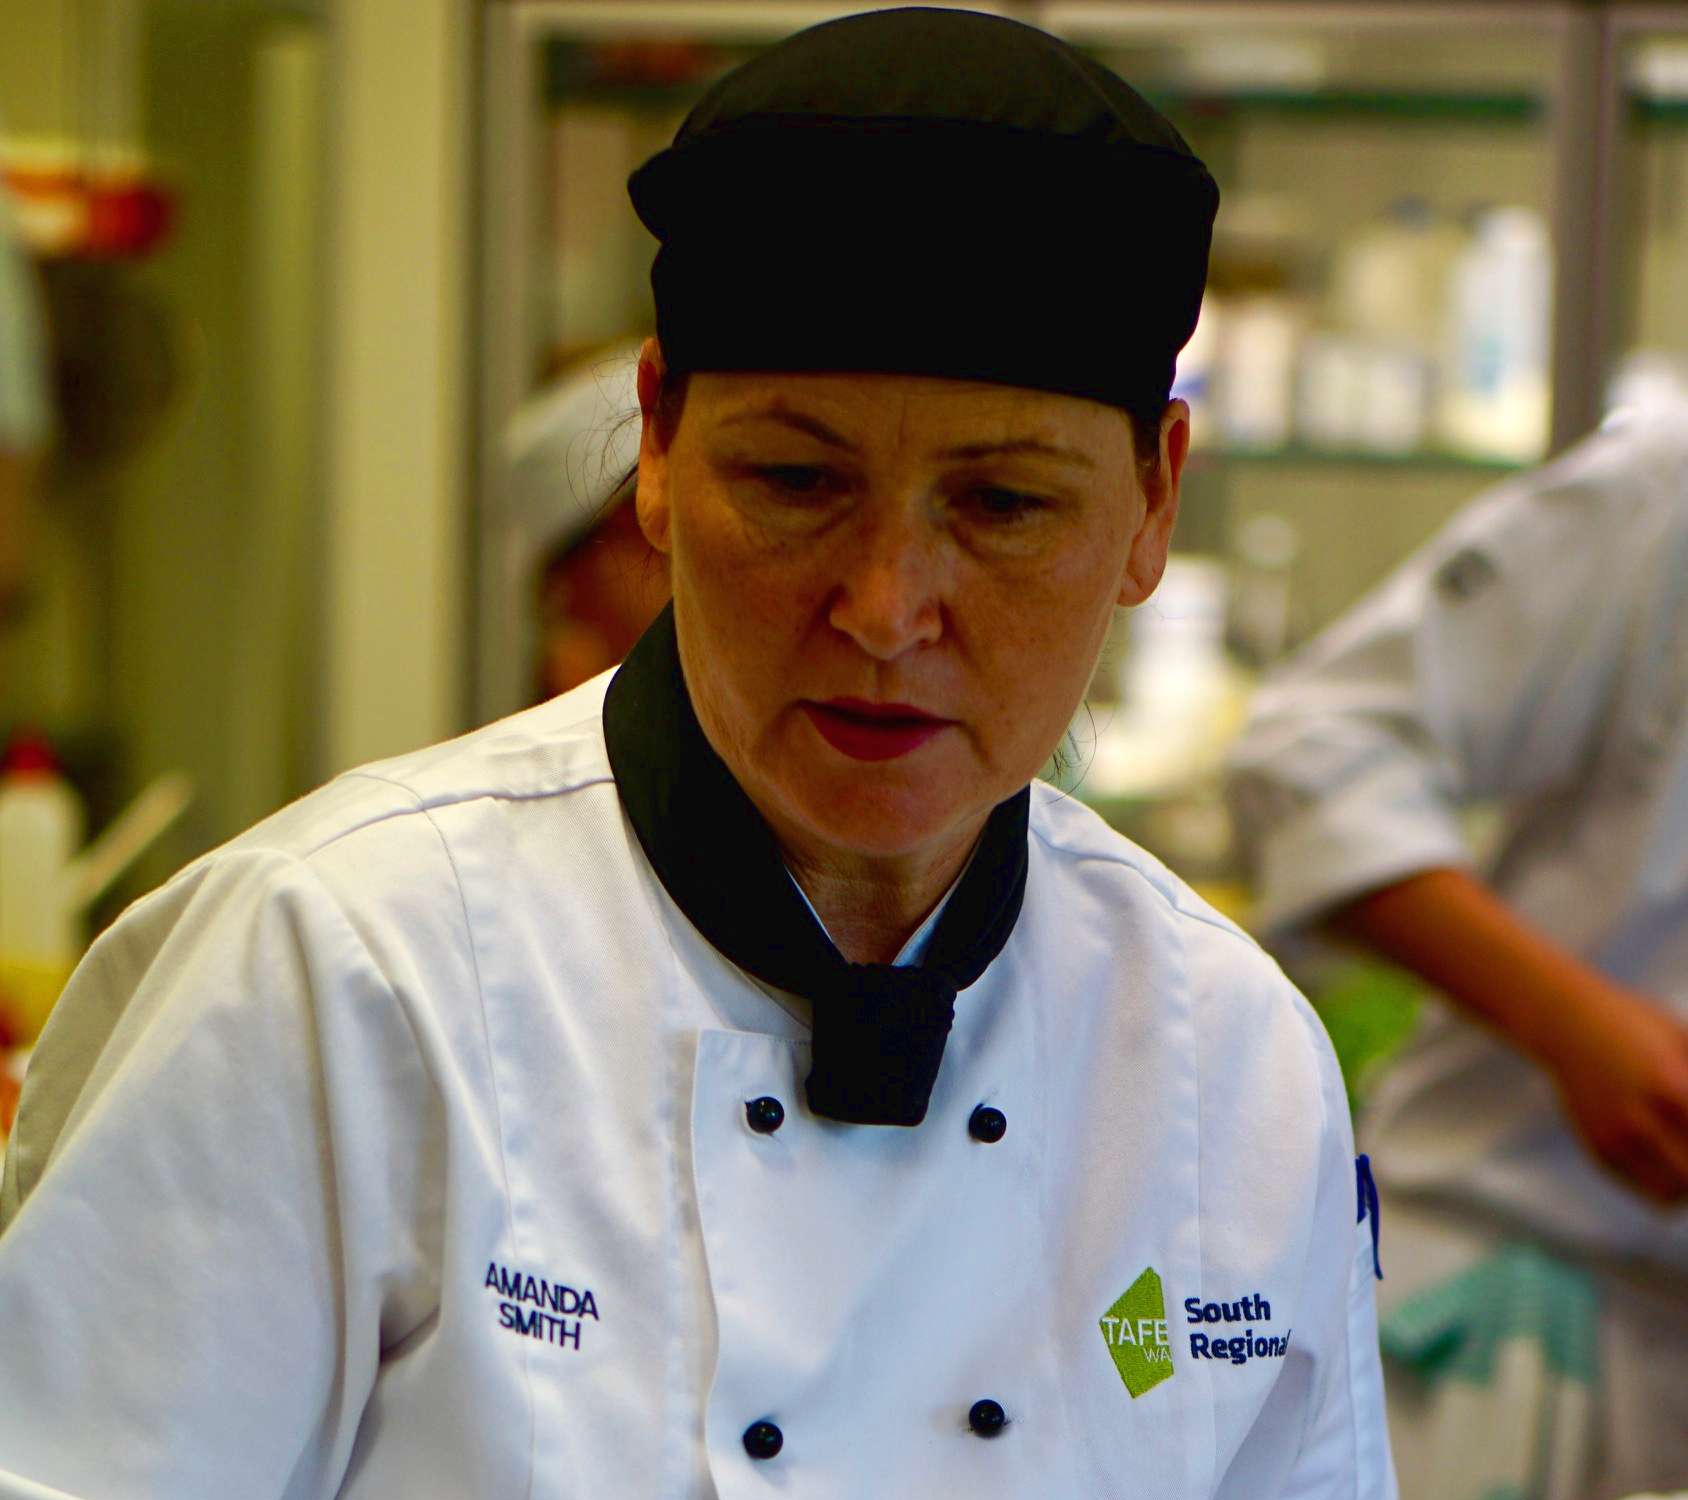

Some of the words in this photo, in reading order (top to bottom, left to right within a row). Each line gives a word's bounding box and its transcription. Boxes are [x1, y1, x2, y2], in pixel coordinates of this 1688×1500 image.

[485, 1262, 599, 1321] AMANDA
[1184, 1293, 1271, 1323] South
[499, 1302, 580, 1350] SMITH
[1101, 1317, 1168, 1346] TAFE
[1143, 1347, 1172, 1363] WA
